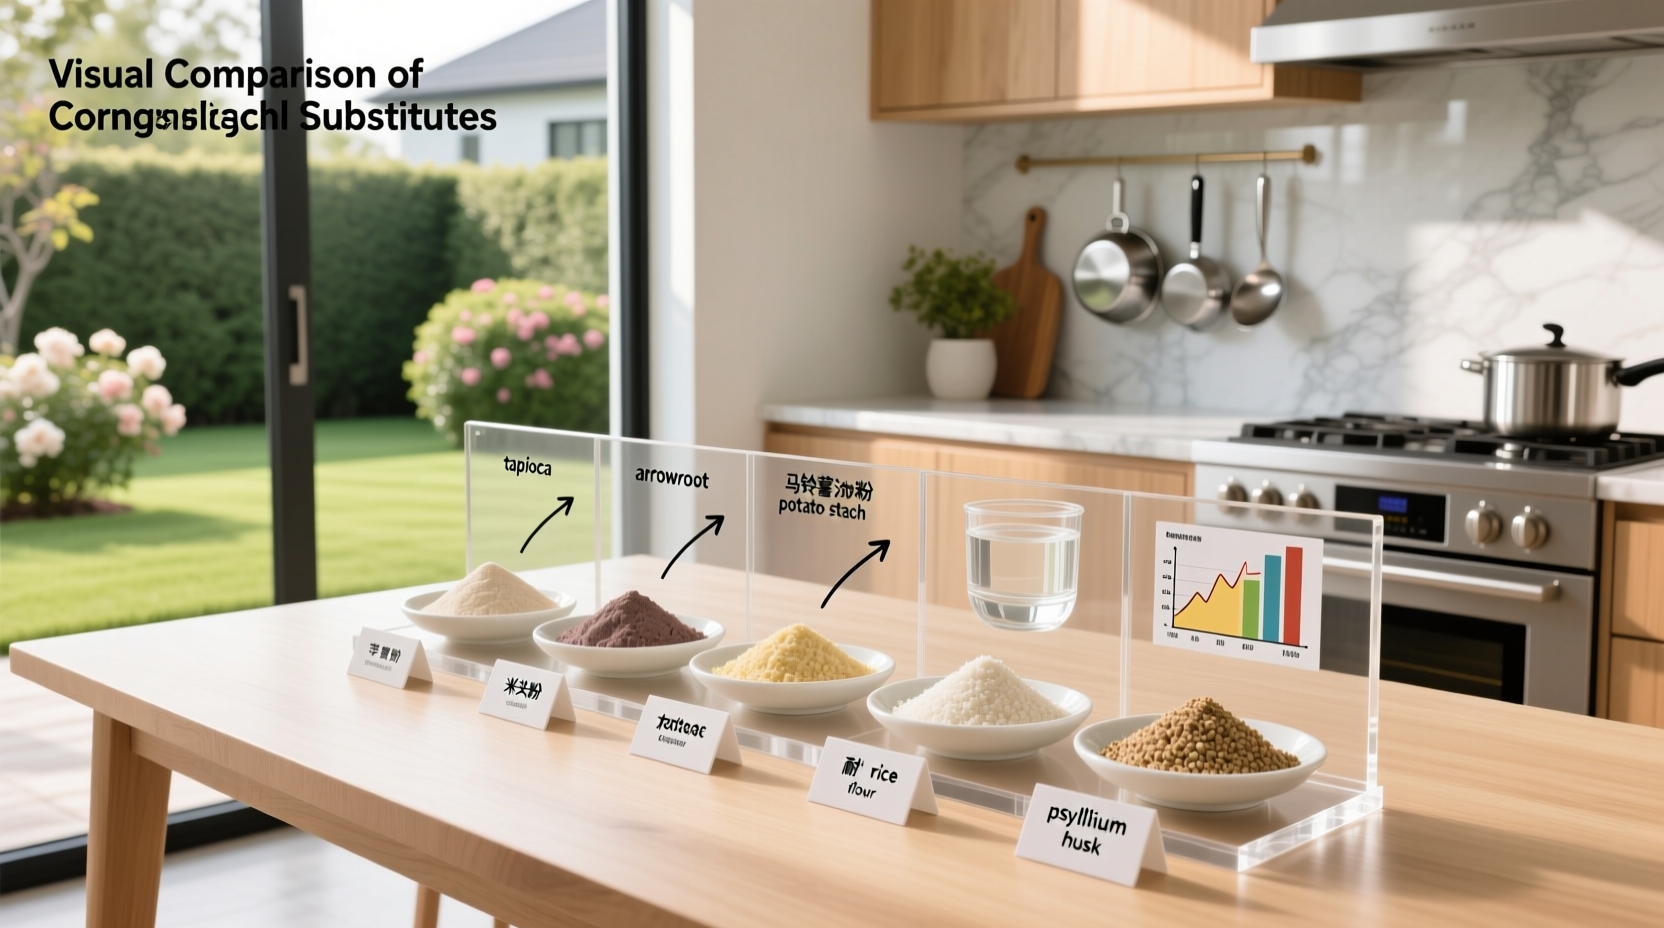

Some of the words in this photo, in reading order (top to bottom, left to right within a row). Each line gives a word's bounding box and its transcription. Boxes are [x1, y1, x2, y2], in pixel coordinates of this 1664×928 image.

[503, 456, 552, 477] tapioca
[635, 467, 710, 489] arrowroot
[778, 497, 826, 516] potato
[870, 763, 898, 784] rice
[1046, 806, 1127, 836] psyllium
[1061, 830, 1102, 857] husk
